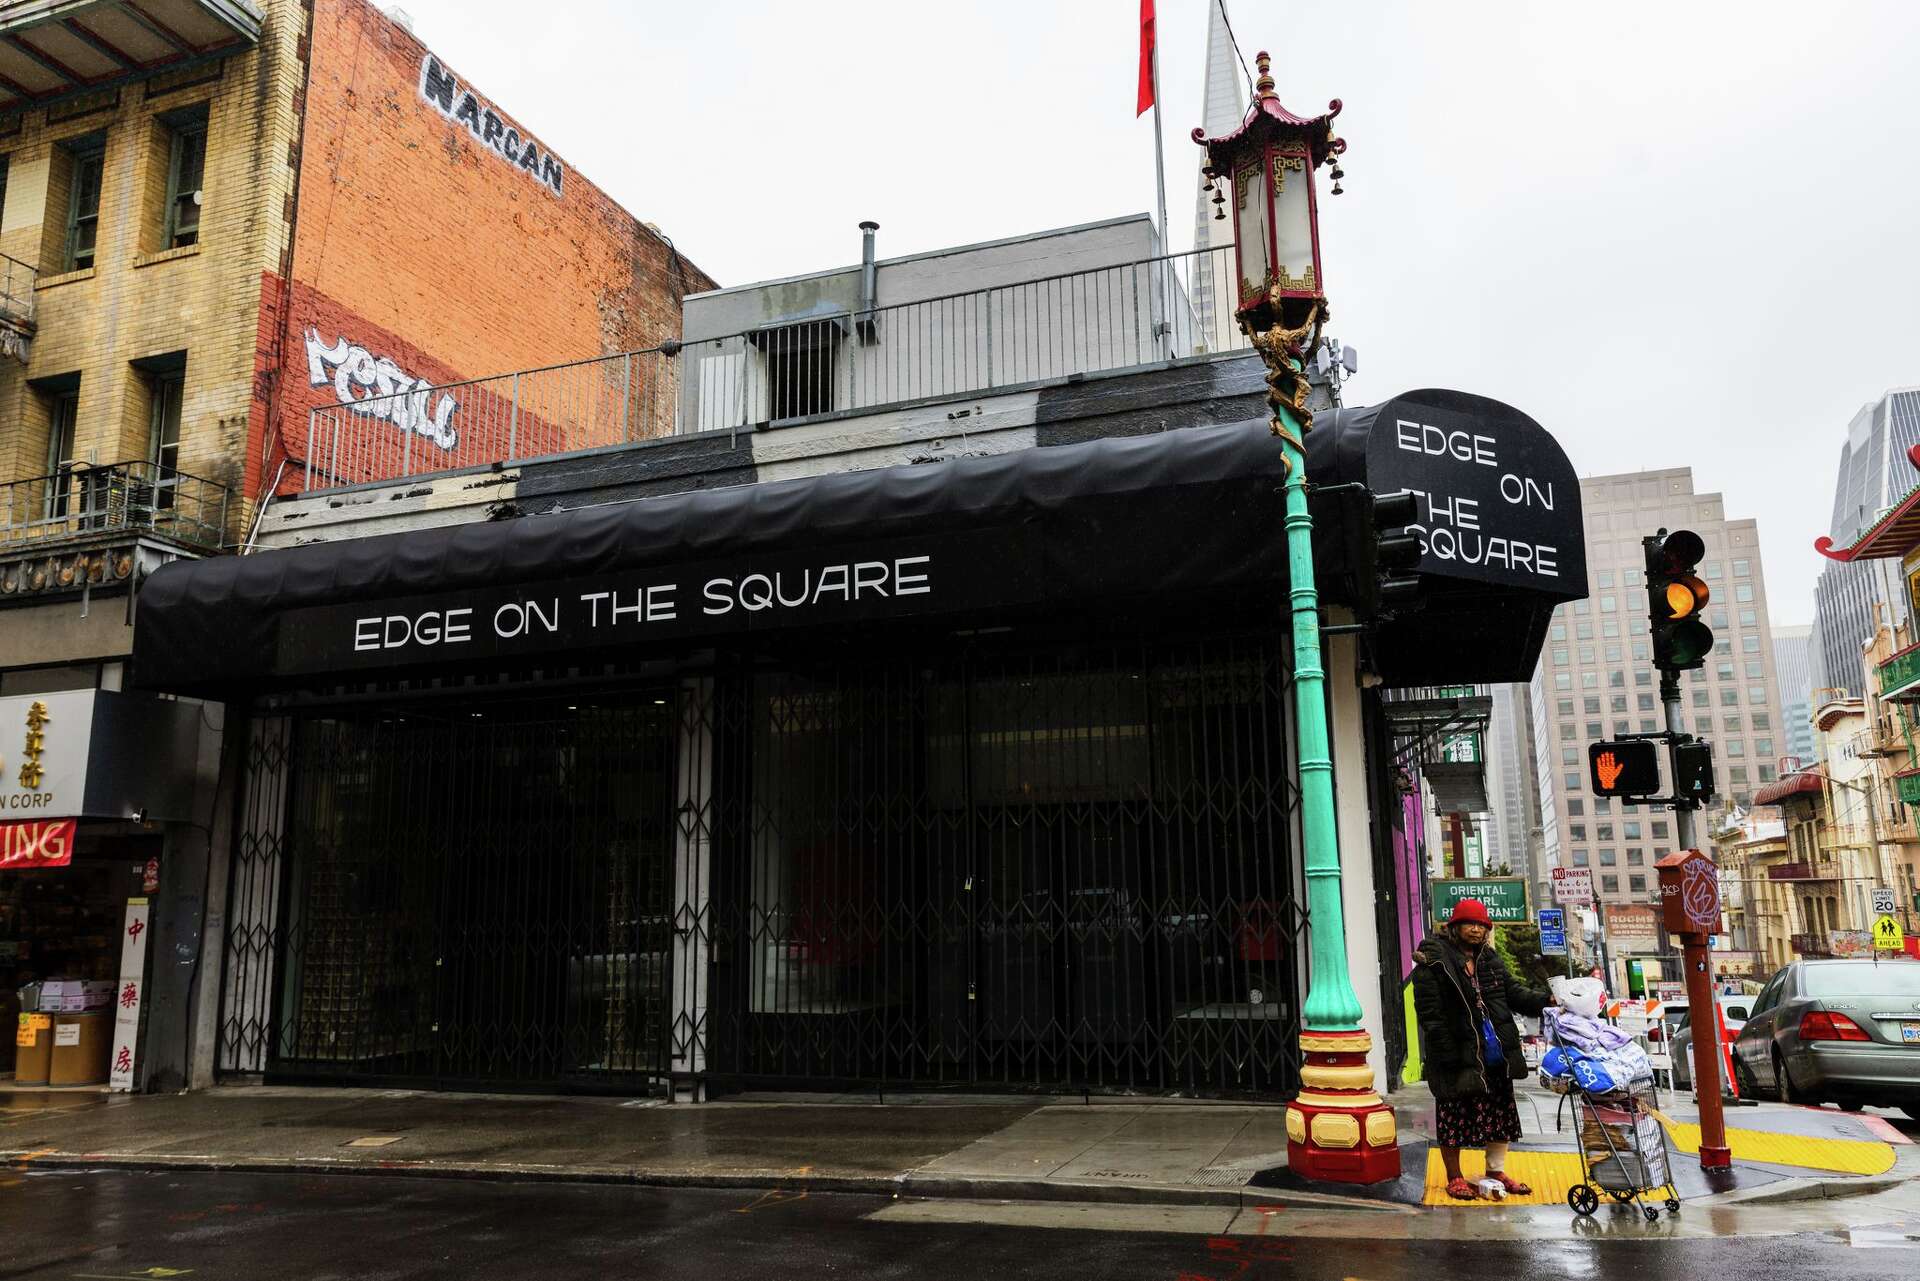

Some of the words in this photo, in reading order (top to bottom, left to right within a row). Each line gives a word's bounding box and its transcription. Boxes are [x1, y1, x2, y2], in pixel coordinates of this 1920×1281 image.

[421, 54, 562, 195] NARCAN
[1397, 419, 1498, 467] EDGE
[1500, 473, 1554, 511] ON
[1404, 523, 1559, 577] SQUARE
[354, 607, 473, 651] EDGE
[494, 597, 559, 638] ON
[580, 584, 678, 627] THE
[702, 555, 932, 615] SQUARE
[10, 793, 53, 809] CORP
[1554, 869, 1565, 879] NO
[1566, 870, 1589, 878] PARKING
[1450, 886, 1508, 895] ORIENTAL
[1460, 896, 1499, 906] ARL
[1442, 907, 1517, 917] RERANT
[1875, 901, 1893, 911] 20
[113, 917, 145, 1075] 中藥房
